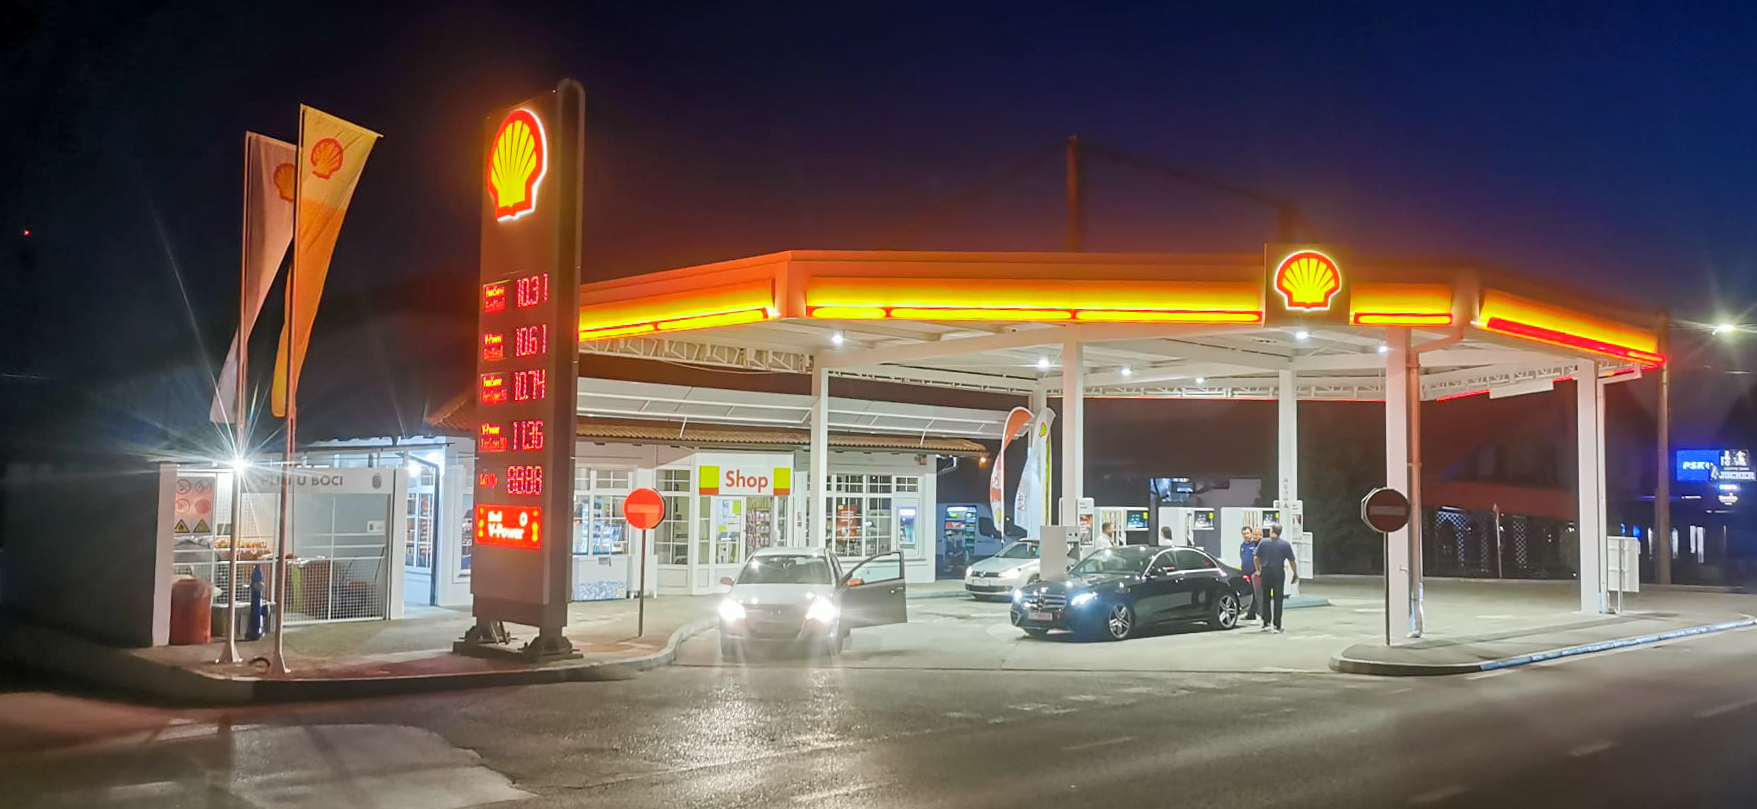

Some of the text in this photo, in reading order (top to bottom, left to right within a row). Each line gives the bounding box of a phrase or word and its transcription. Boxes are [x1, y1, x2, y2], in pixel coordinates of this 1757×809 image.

[297, 475, 307, 486] U
[311, 475, 344, 487] BOCI
[725, 468, 769, 493] Shop
[487, 522, 525, 540] V-Power
